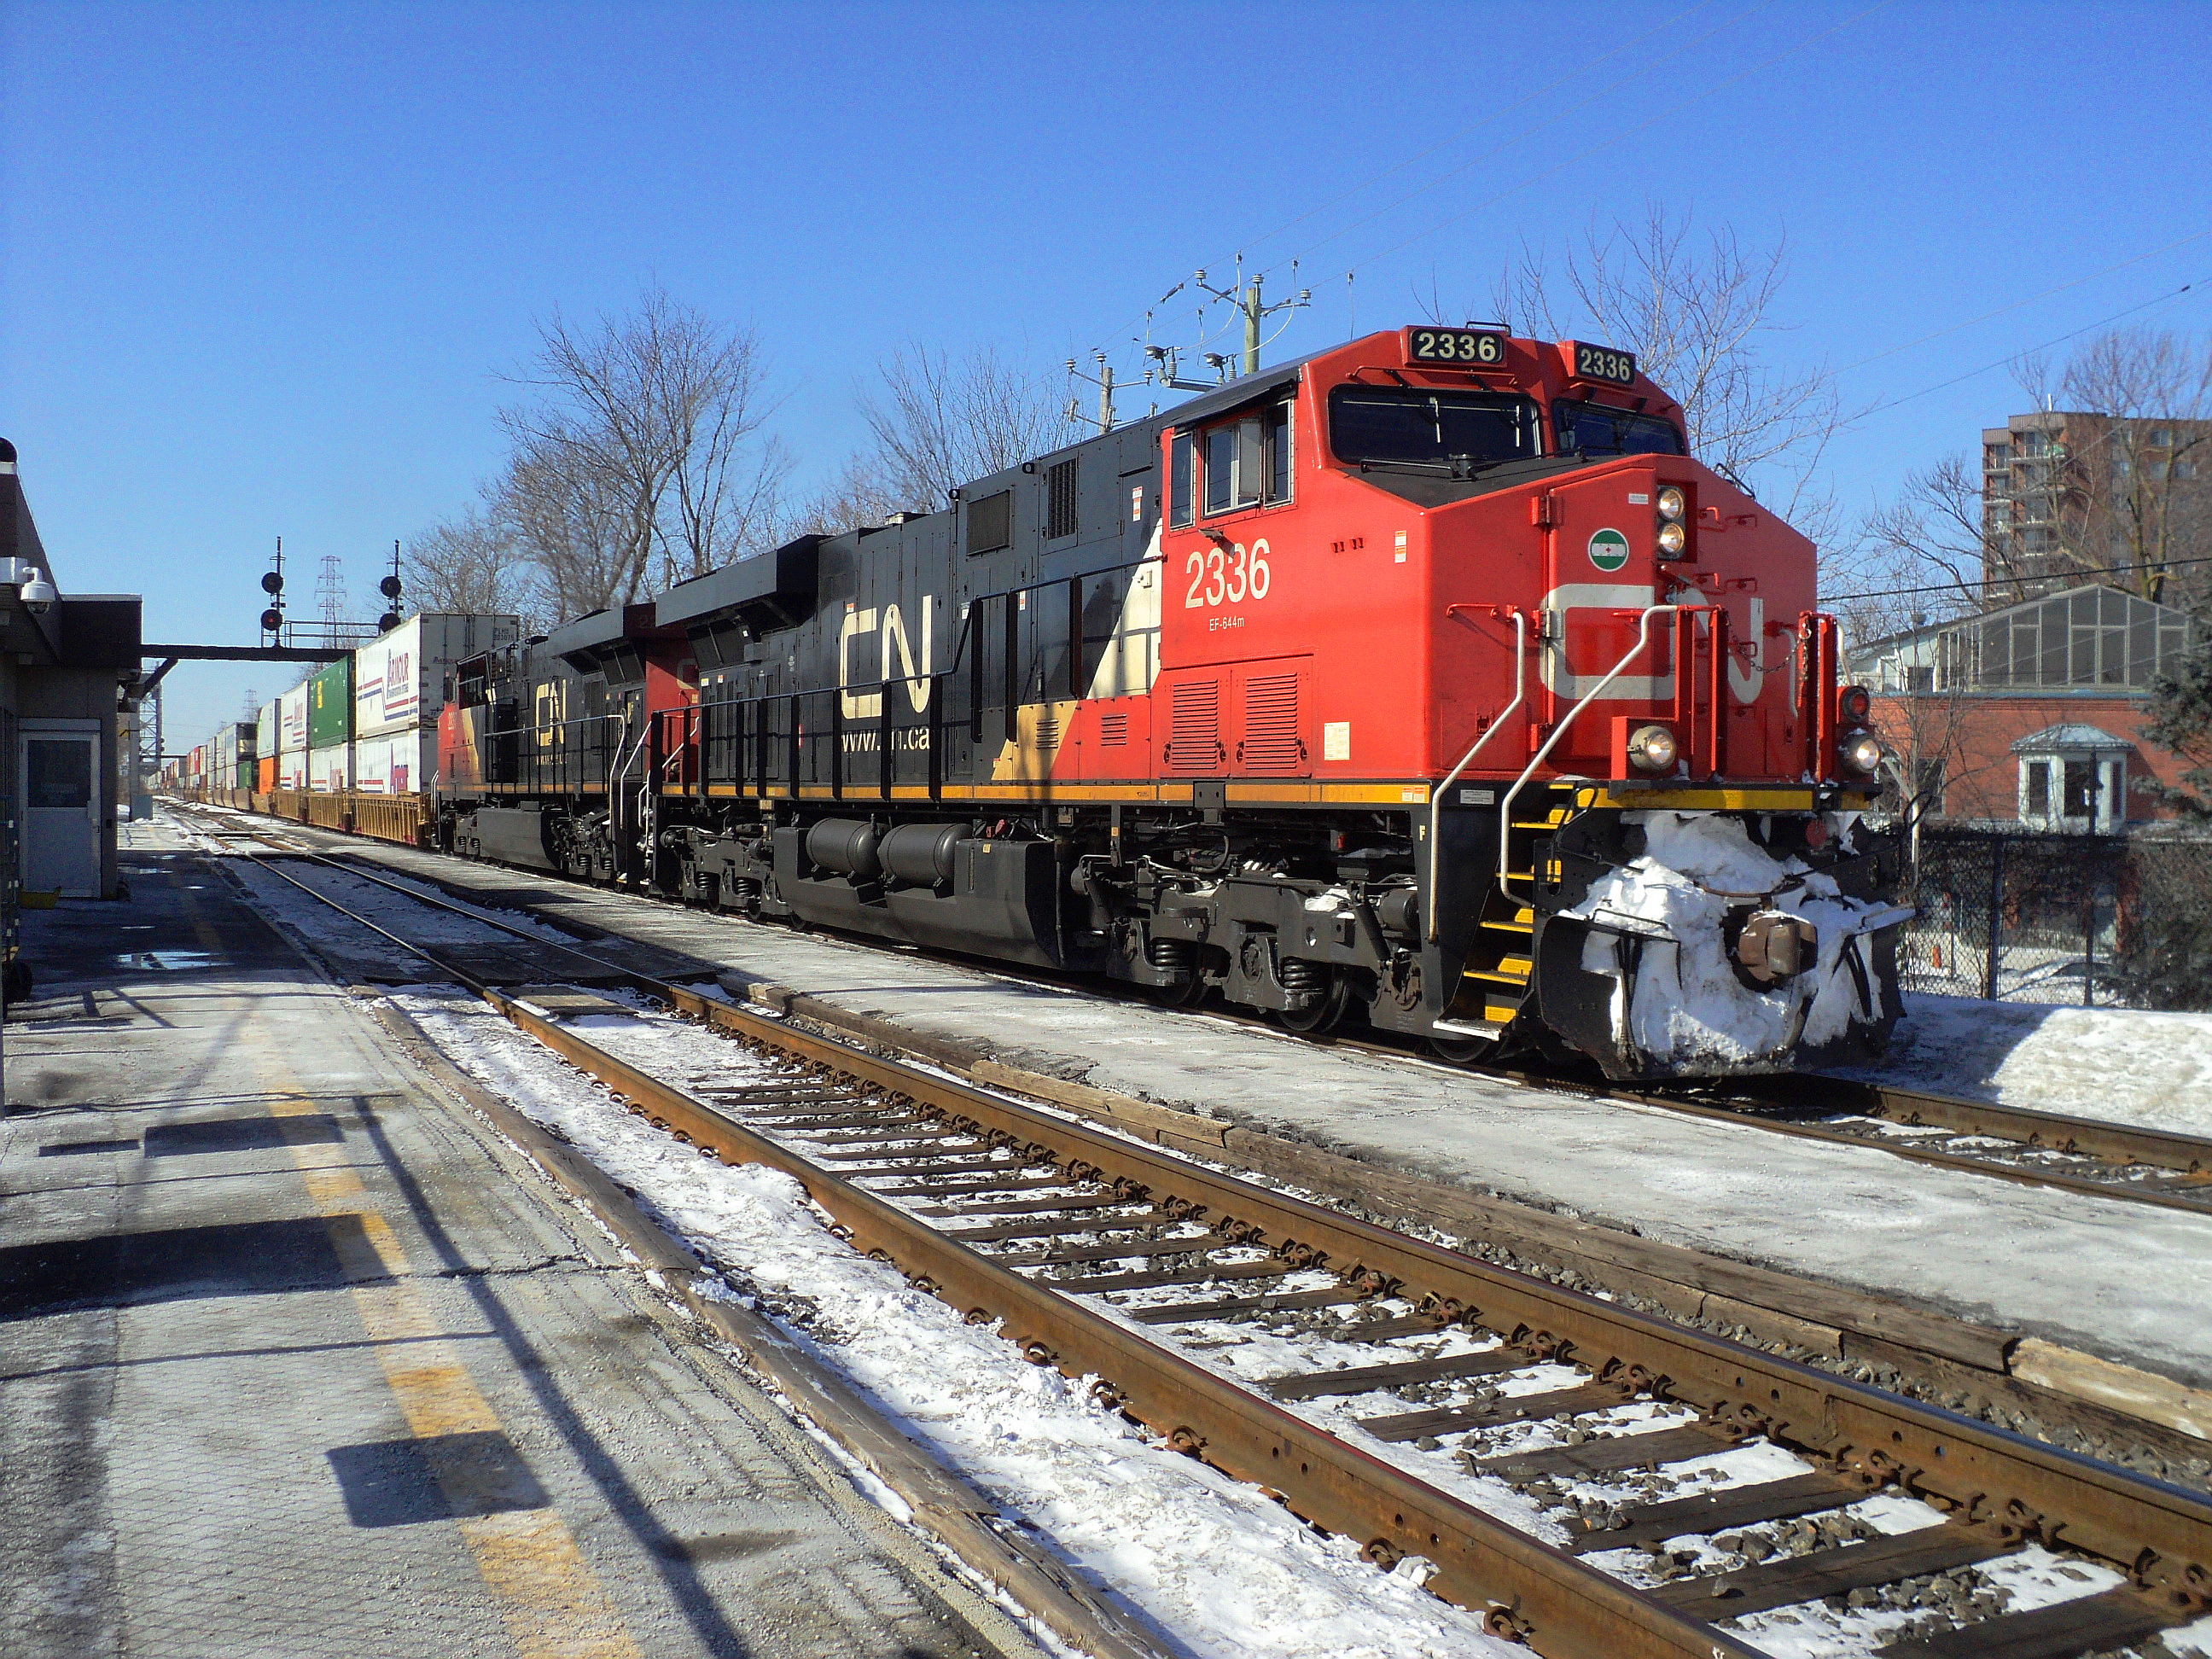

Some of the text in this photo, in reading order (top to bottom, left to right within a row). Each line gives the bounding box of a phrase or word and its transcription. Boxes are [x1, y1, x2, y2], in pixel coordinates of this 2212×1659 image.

[1418, 332, 1496, 361] 2336
[1580, 348, 1630, 381] 2336
[1185, 538, 1271, 608] 2336
[1209, 615, 1244, 632] EF-644m
[840, 595, 932, 719] CN
[1540, 584, 1764, 703] CN
[840, 726, 930, 753] www.n.ca
[1419, 824, 1426, 841] F
